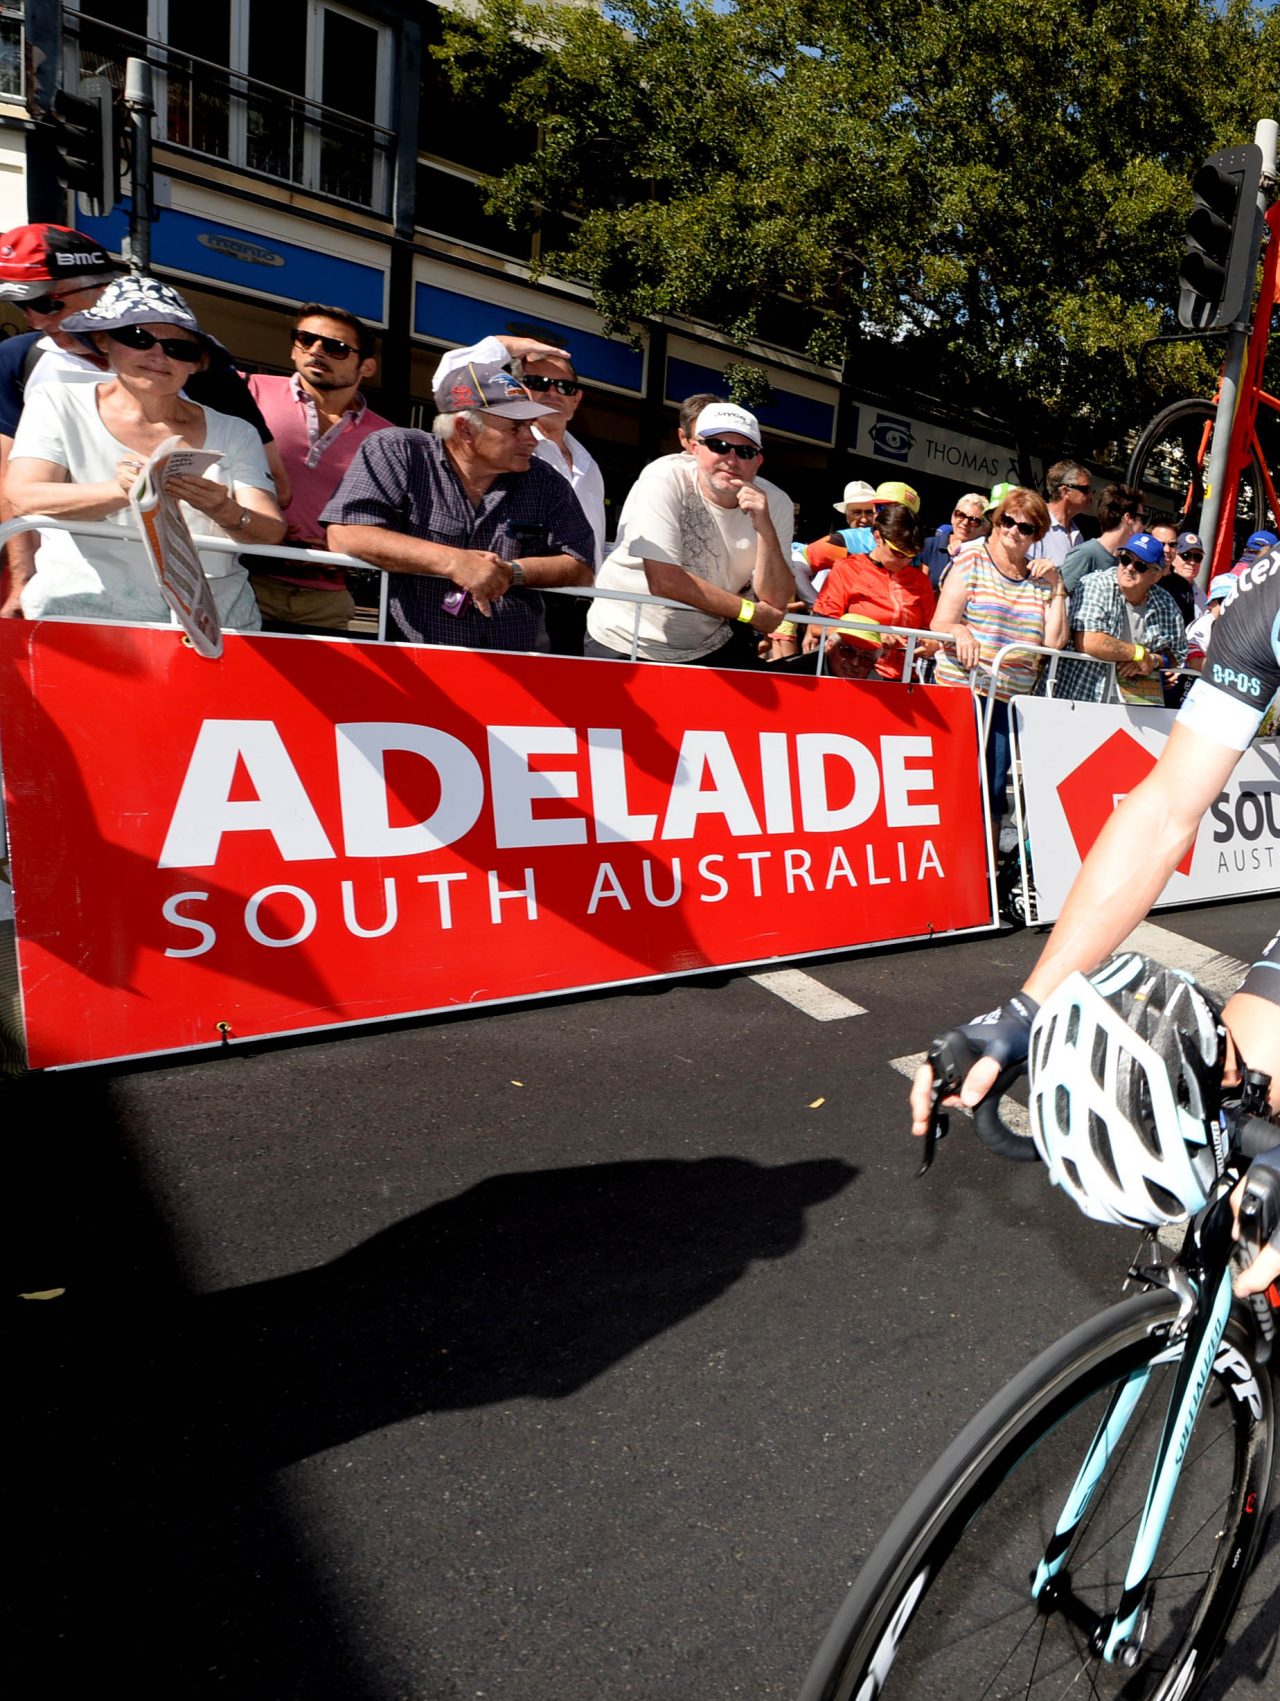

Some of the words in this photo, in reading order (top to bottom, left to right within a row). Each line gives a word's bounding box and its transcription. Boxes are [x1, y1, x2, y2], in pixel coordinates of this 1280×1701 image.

[56, 252, 104, 266] BMC
[926, 438, 999, 478] THOMAS
[157, 719, 941, 869] ADELAIDE
[162, 870, 540, 959] SOUTH
[587, 838, 946, 916] AUSTRALIA
